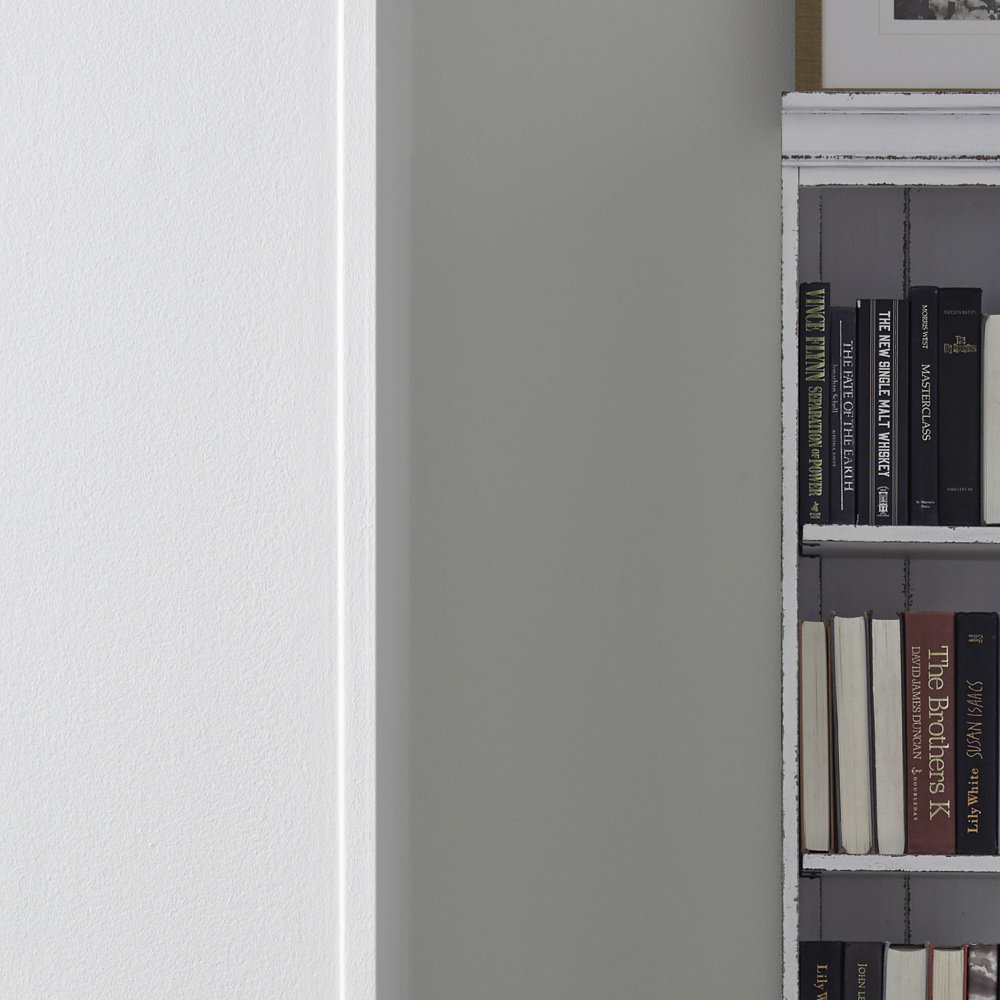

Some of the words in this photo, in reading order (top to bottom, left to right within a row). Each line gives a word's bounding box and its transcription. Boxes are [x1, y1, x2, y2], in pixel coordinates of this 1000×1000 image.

[805, 288, 825, 332] VINCE
[878, 310, 891, 332] THE
[921, 304, 929, 330] MORRIS
[843, 340, 854, 367] THE
[878, 334, 891, 358] NEW
[921, 331, 929, 350] WEST
[804, 336, 826, 382] FLYNN
[843, 369, 854, 399] FATE
[878, 361, 891, 396] SINGLE
[808, 386, 822, 448] SEPARATION
[843, 401, 854, 417] OF
[878, 399, 891, 428] MALT
[921, 364, 931, 441] MASTERCLASS
[843, 416, 854, 446] THE
[843, 449, 855, 492] EARTH
[878, 432, 890, 477] WHISKEY
[808, 458, 822, 496] POWER
[911, 646, 921, 679] DAVID
[927, 645, 949, 690] The
[911, 679, 922, 713] JAMES
[965, 680, 984, 717] ISAACS
[911, 713, 922, 759] DUNCAN
[928, 695, 950, 794] Brothers
[965, 721, 984, 759] SUSAN
[966, 768, 980, 806] White
[929, 799, 950, 821] K
[966, 807, 981, 833] Lily
[813, 964, 828, 990] Lily
[857, 963, 868, 988] JOHN
